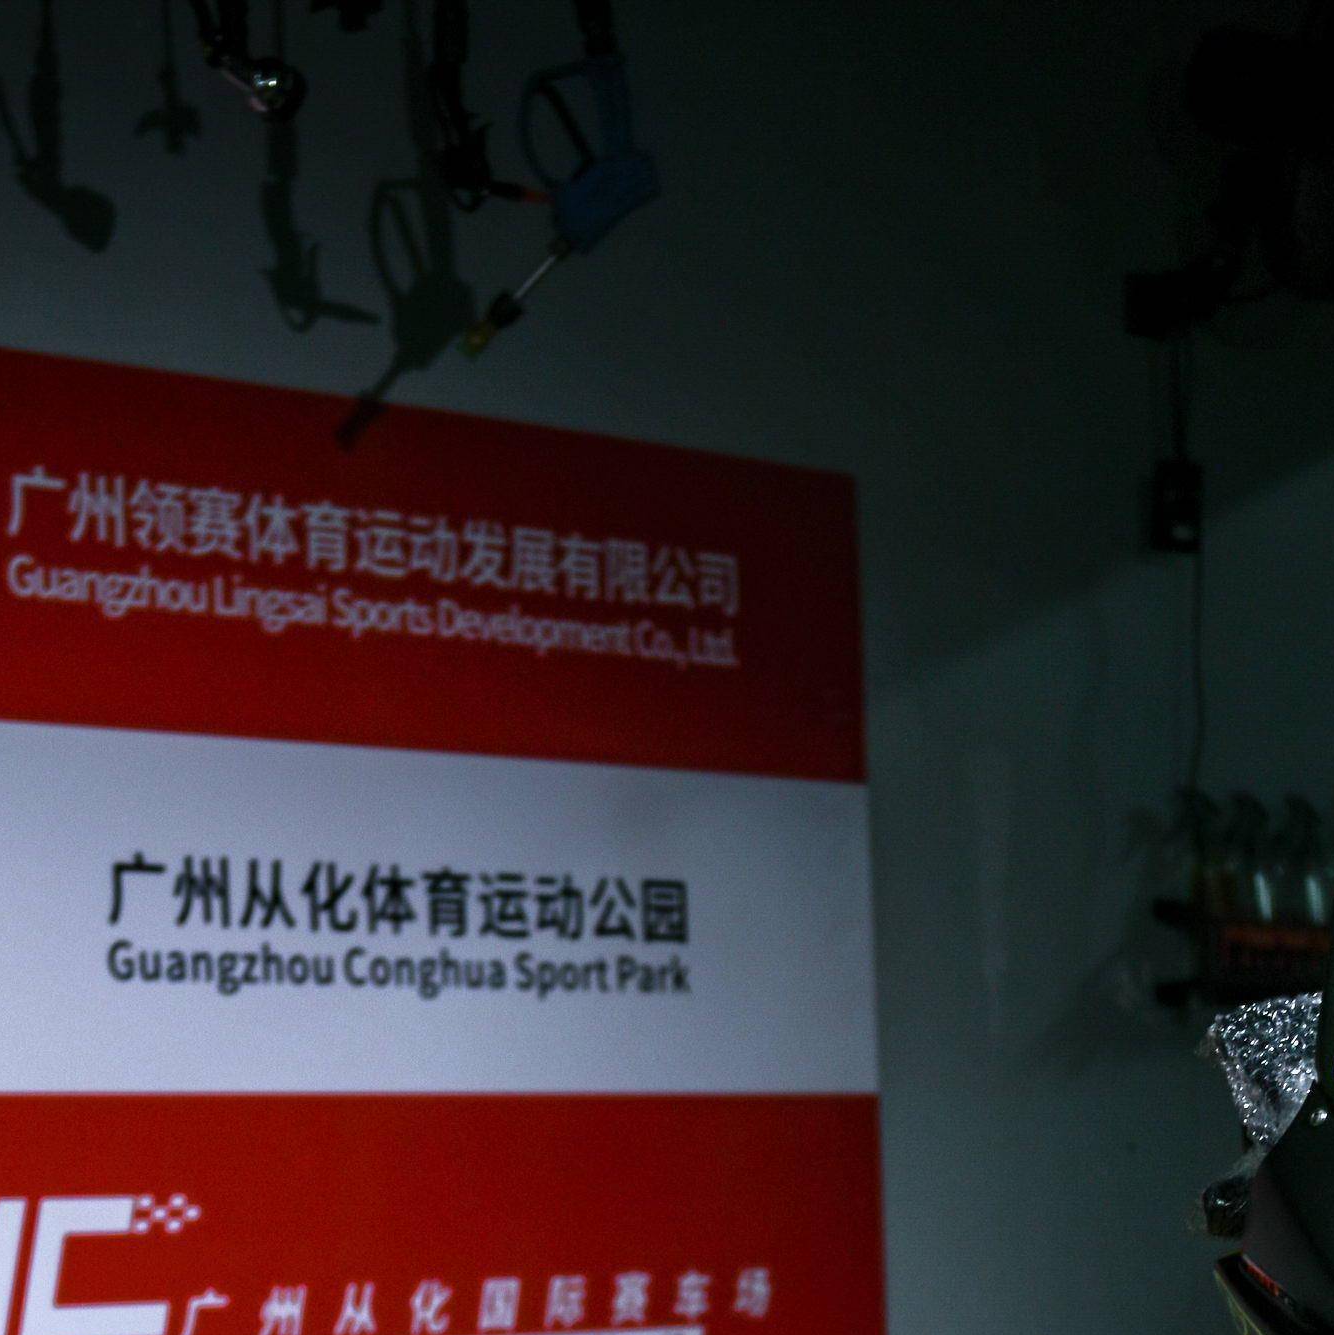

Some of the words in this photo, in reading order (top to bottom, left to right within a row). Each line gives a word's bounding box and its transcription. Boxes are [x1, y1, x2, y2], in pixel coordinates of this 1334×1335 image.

[6, 464, 741, 618] 广州领赛体育运动发展有限公司
[6, 553, 208, 619] Guangzhou
[212, 572, 328, 635] Lingsai
[331, 585, 434, 641] Sports
[436, 597, 631, 657] Development
[108, 851, 688, 943] 广州从化体育运动公园
[107, 938, 335, 996] Guangzhou
[342, 946, 506, 1000] Conghua
[514, 951, 609, 1000] Sport
[618, 953, 690, 994] Park
